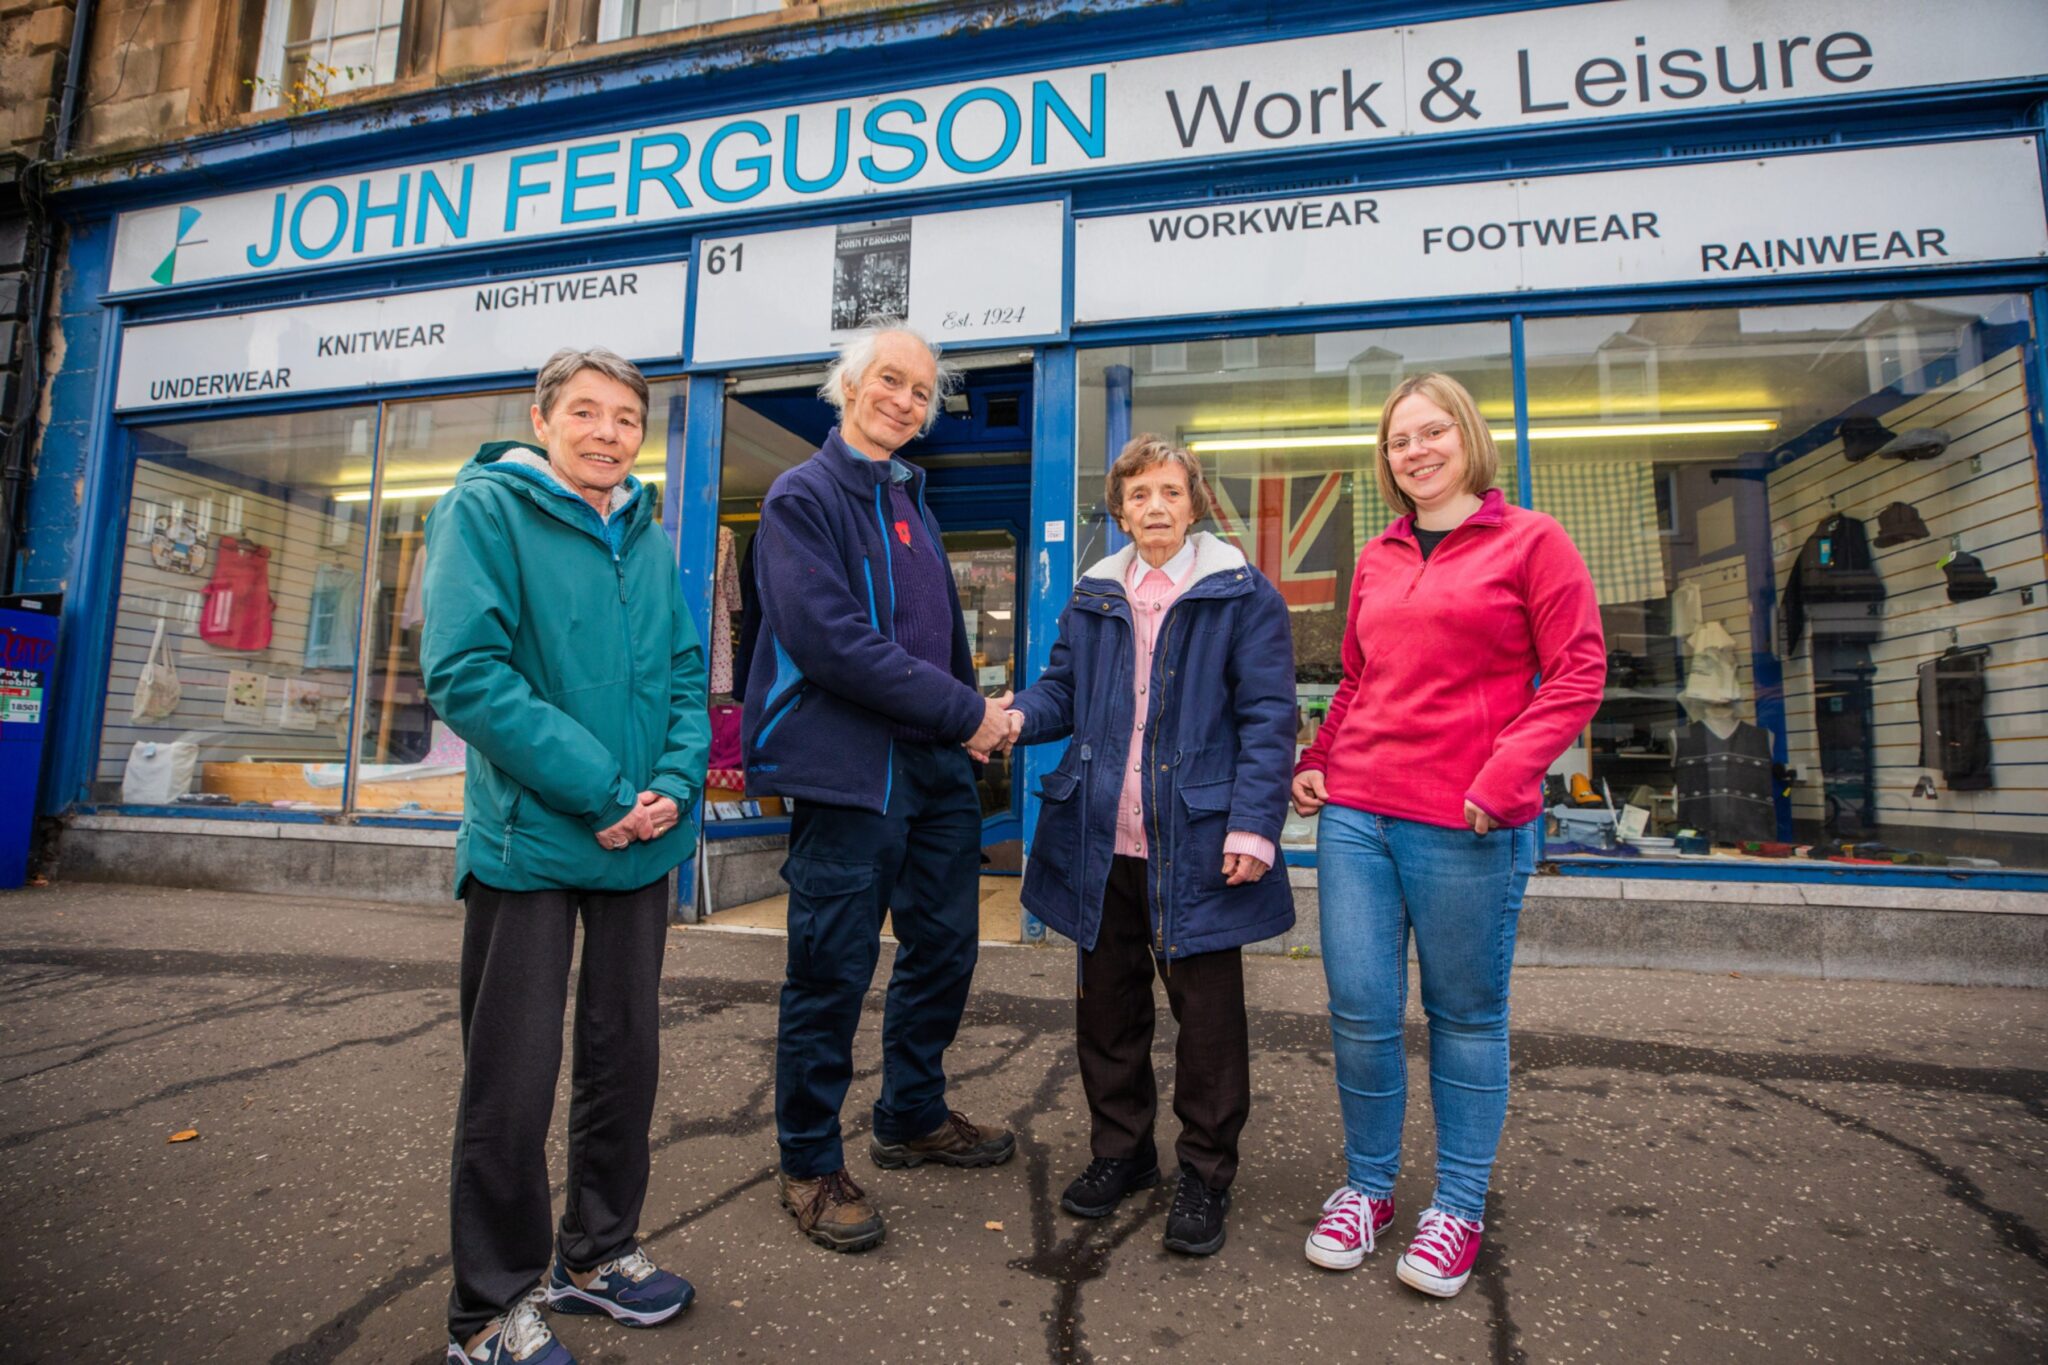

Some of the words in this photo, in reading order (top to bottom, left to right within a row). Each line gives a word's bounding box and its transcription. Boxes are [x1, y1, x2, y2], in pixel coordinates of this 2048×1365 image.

[246, 163, 475, 268] JOHN
[505, 73, 1105, 231] FERGUSON
[1166, 70, 1385, 147] Work
[1421, 58, 1480, 122] &
[1518, 32, 1872, 113] Leisure
[1150, 200, 1378, 242] WORKWEAR
[1424, 213, 1659, 254] FOOTWEAR
[837, 236, 862, 249] JOHN
[863, 231, 910, 247] FERGUSON
[1702, 229, 1948, 271] RAINWEAR
[707, 243, 743, 275] 61
[476, 273, 638, 312] NIGHTWEAR
[942, 311, 973, 330] Est.
[982, 306, 1026, 327] 1924
[318, 324, 445, 357] KNITWEAR
[151, 367, 291, 401] UNDERWEAR
[23, 669, 38, 680] by
